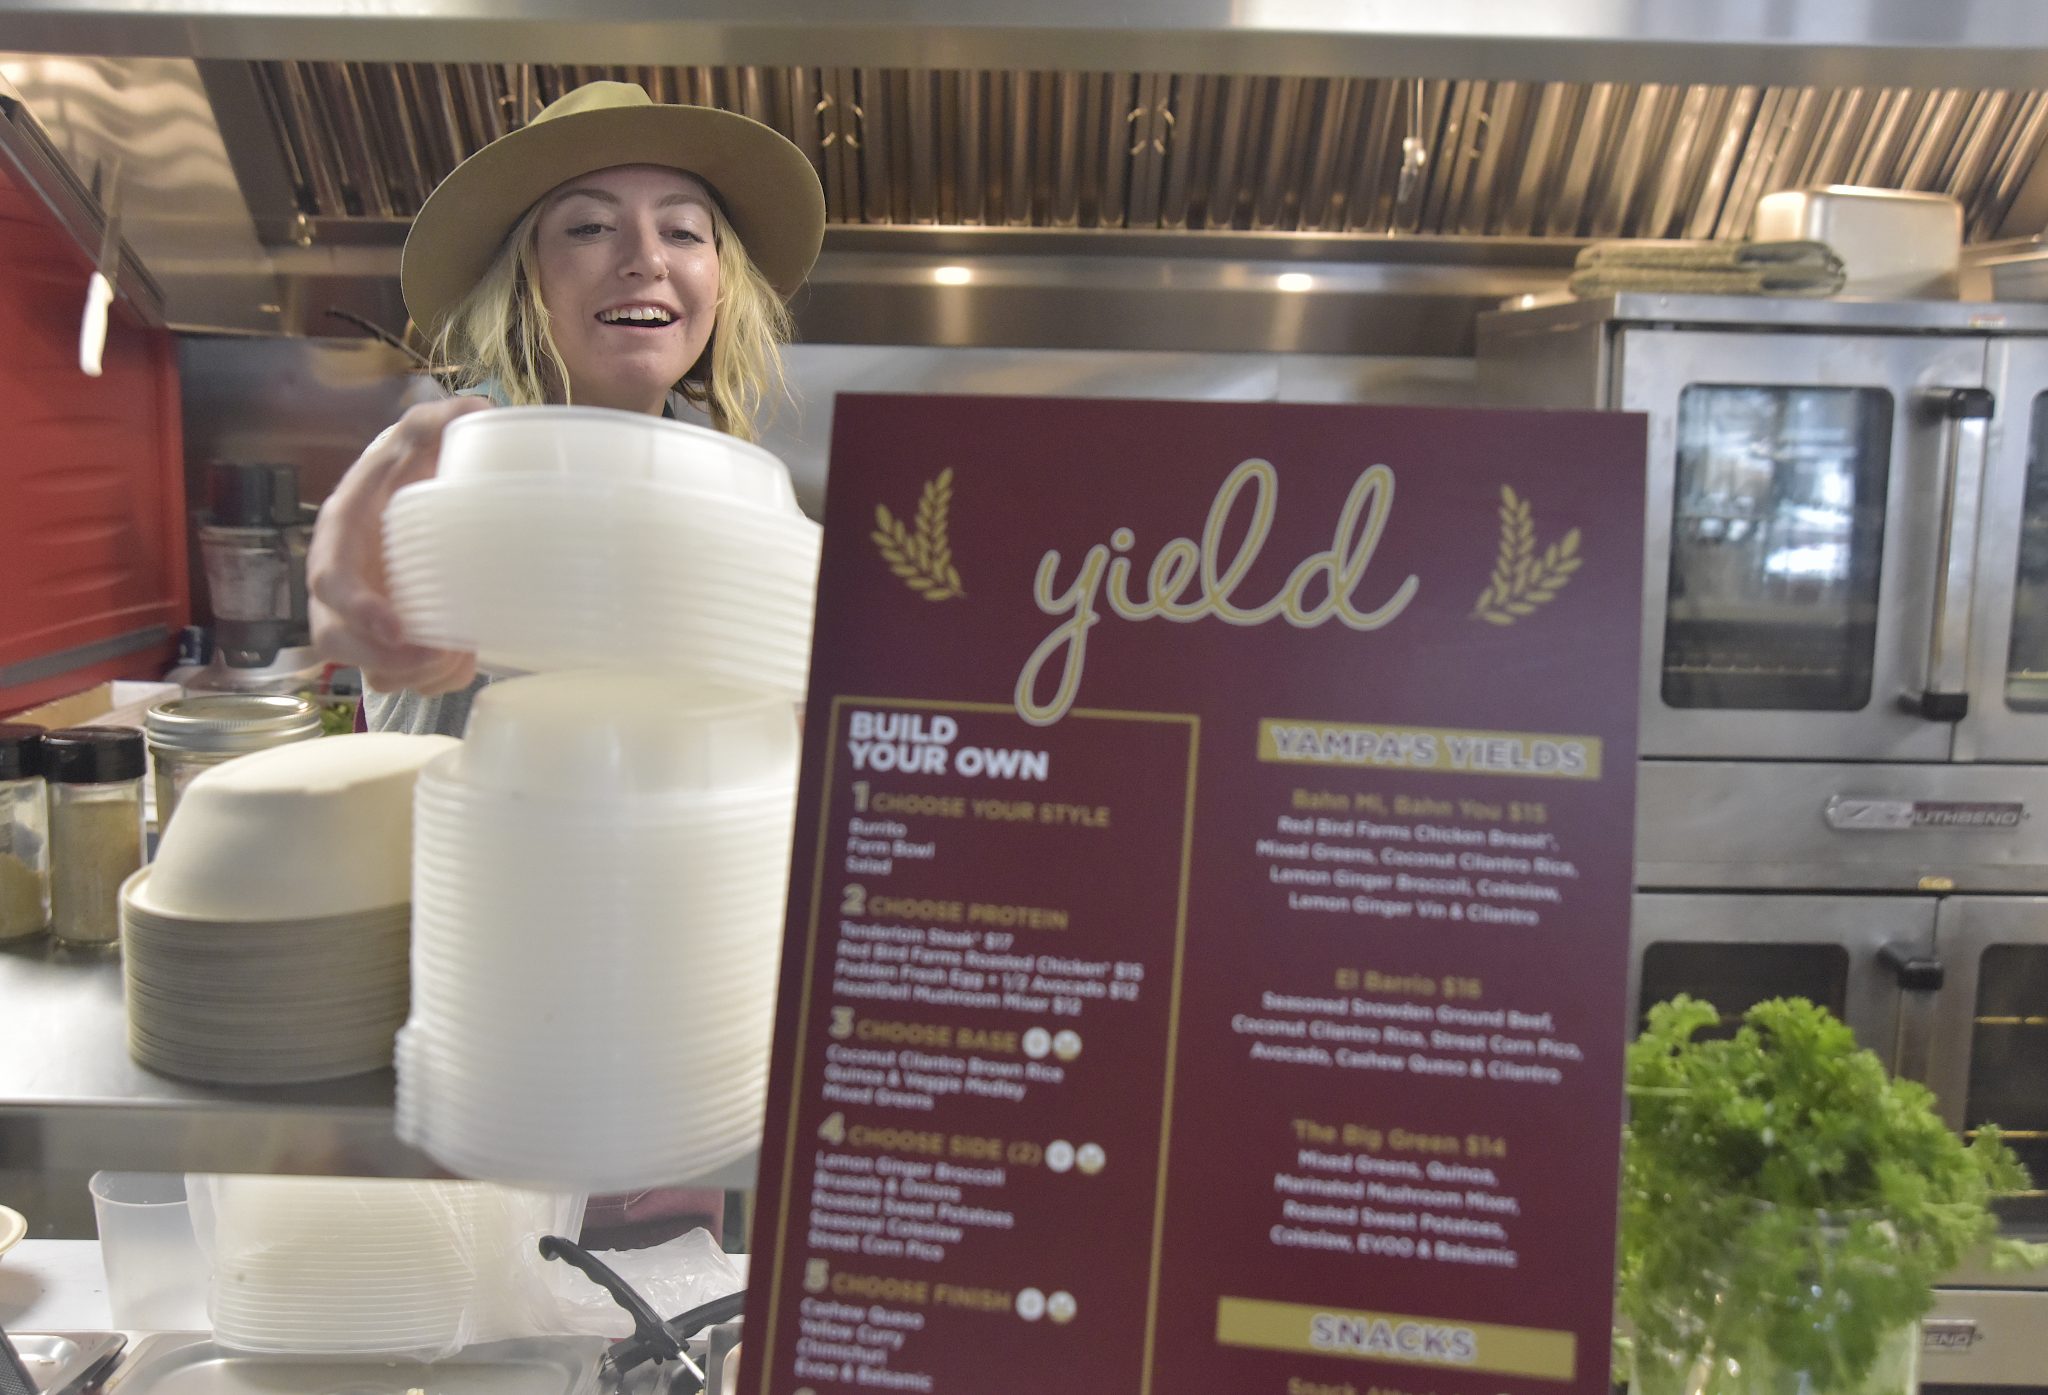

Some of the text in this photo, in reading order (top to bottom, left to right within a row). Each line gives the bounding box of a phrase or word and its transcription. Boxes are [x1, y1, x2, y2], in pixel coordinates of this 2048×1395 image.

[1014, 458, 1419, 727] yield
[849, 712, 958, 744] BUILD
[1270, 725, 1586, 776] YAMPA'S YIELDS
[848, 741, 1050, 780] YOUR OWN
[852, 781, 1111, 826] 1 CHOOSE YOUR STYLE
[841, 884, 1069, 929] 2 CHOOSE PROTEIN
[829, 1006, 1019, 1052] 3 CHOOSE BASE
[818, 1112, 846, 1146] 4
[849, 1126, 945, 1152] CHOOSE
[949, 1136, 1003, 1160] SIDE
[803, 1258, 1011, 1312] 5 CHOOSE FINISH
[1309, 1312, 1476, 1364] SNACKS
